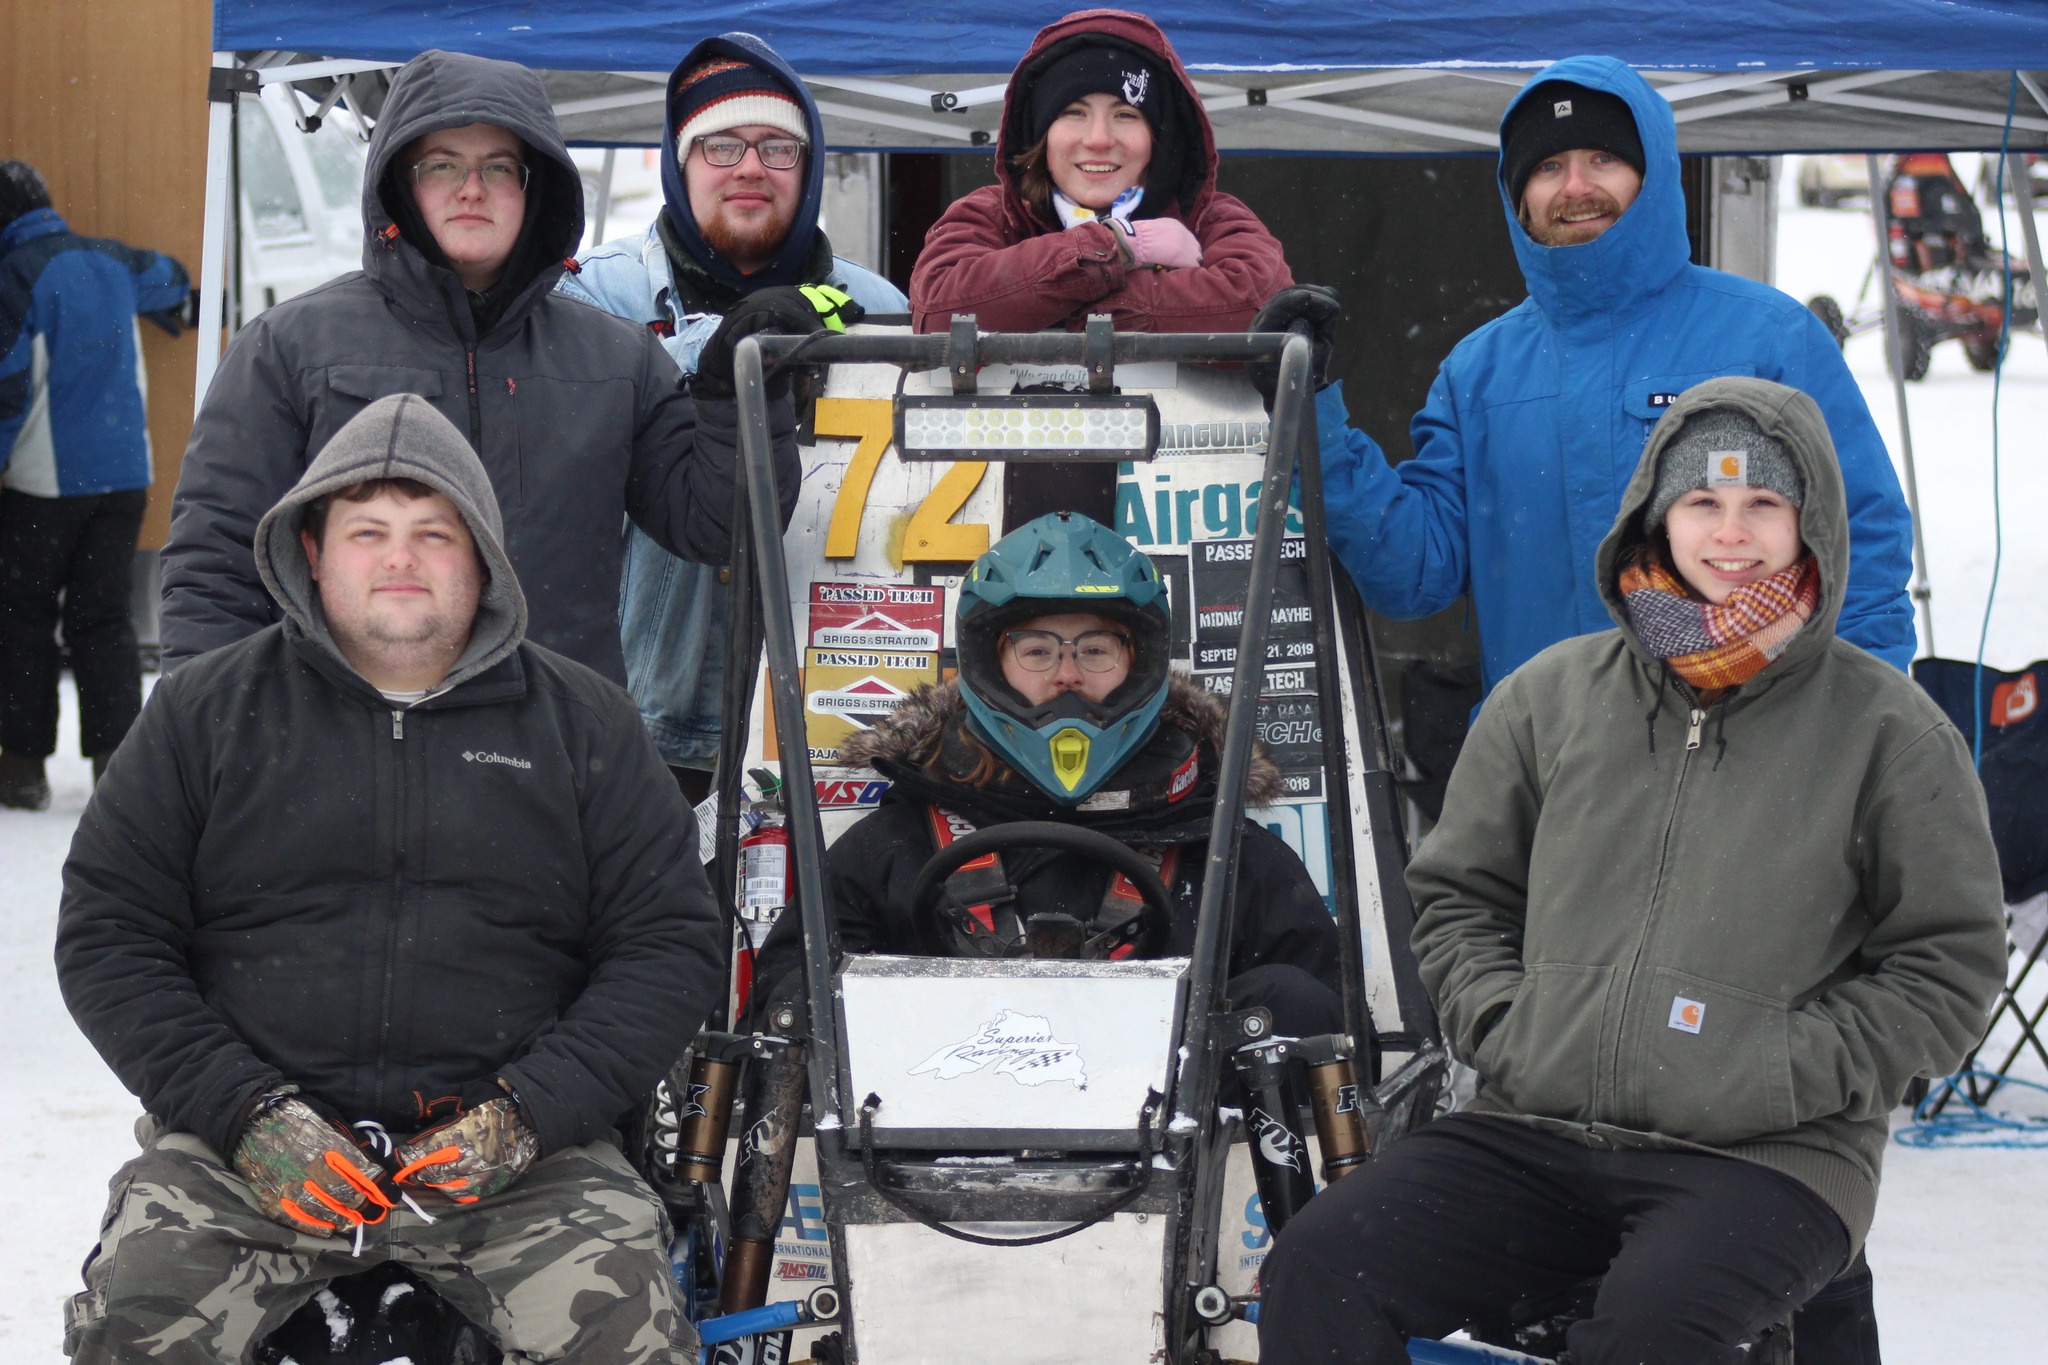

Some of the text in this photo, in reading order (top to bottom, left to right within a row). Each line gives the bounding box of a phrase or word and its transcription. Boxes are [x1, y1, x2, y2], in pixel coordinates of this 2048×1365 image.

[1160, 422, 1270, 449] ANGUAR
[1205, 541, 1306, 562] PASSE ECH
[821, 587, 934, 604] PASSED TECH
[1200, 607, 1312, 628] MIDNI AYHE
[816, 652, 928, 668] PASSED TECH
[1200, 648, 1238, 662] SEPTE
[1286, 643, 1314, 657] 2019
[1204, 671, 1305, 694] PAS TECH
[1256, 721, 1313, 745] ECH
[475, 751, 531, 768] Columbia
[807, 748, 839, 760] BAJA
[814, 781, 890, 804] MSO
[977, 1028, 1053, 1048] Superior
[774, 1184, 828, 1242] AE
[774, 1243, 830, 1258] ERNATIONAL
[777, 1261, 828, 1280] AMSOIL
